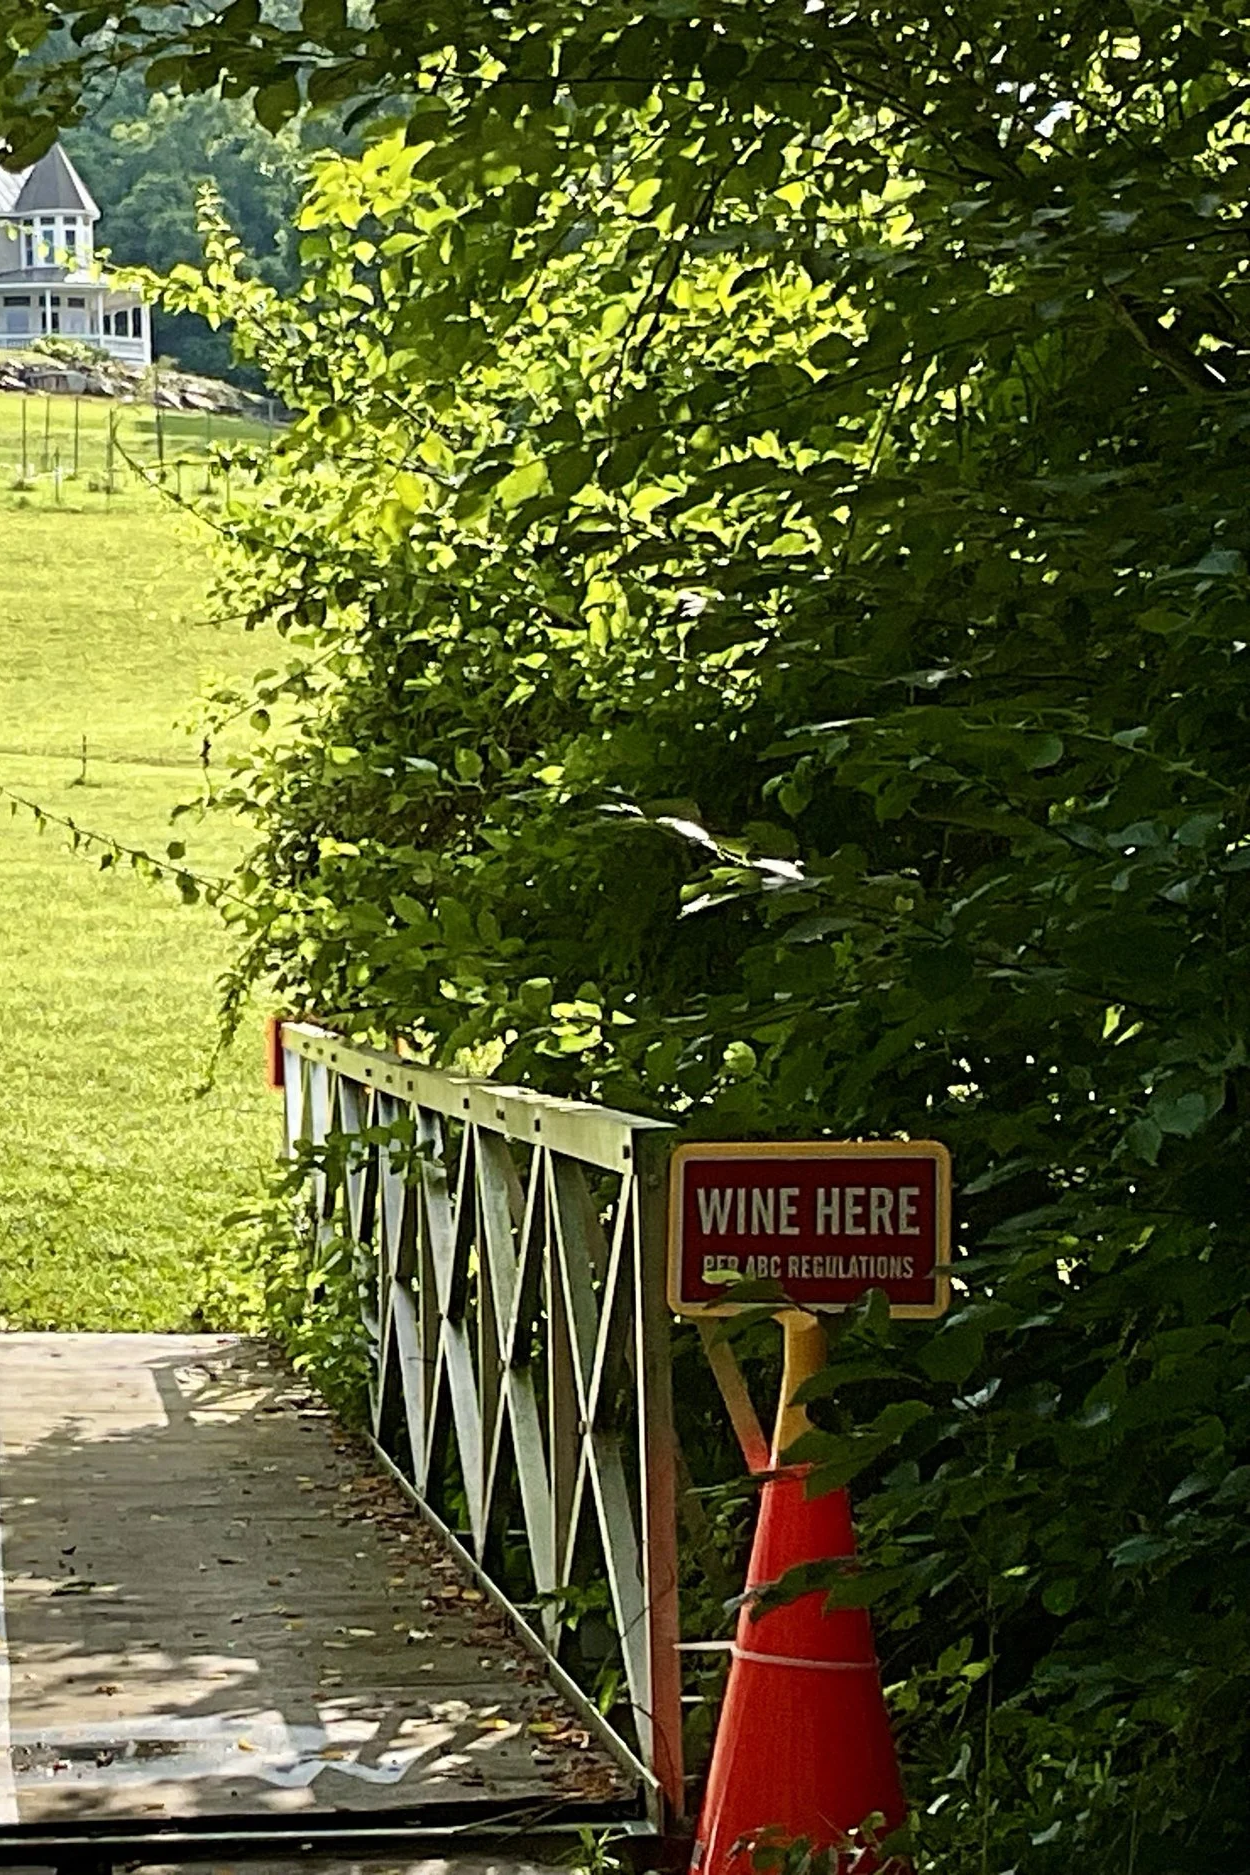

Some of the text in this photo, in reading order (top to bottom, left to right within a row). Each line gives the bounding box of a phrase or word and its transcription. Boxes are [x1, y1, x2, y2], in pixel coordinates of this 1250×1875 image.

[697, 1187, 921, 1236] WINE HERE
[746, 1255, 782, 1279] ABC
[788, 1255, 915, 1280] REGULATIONS
